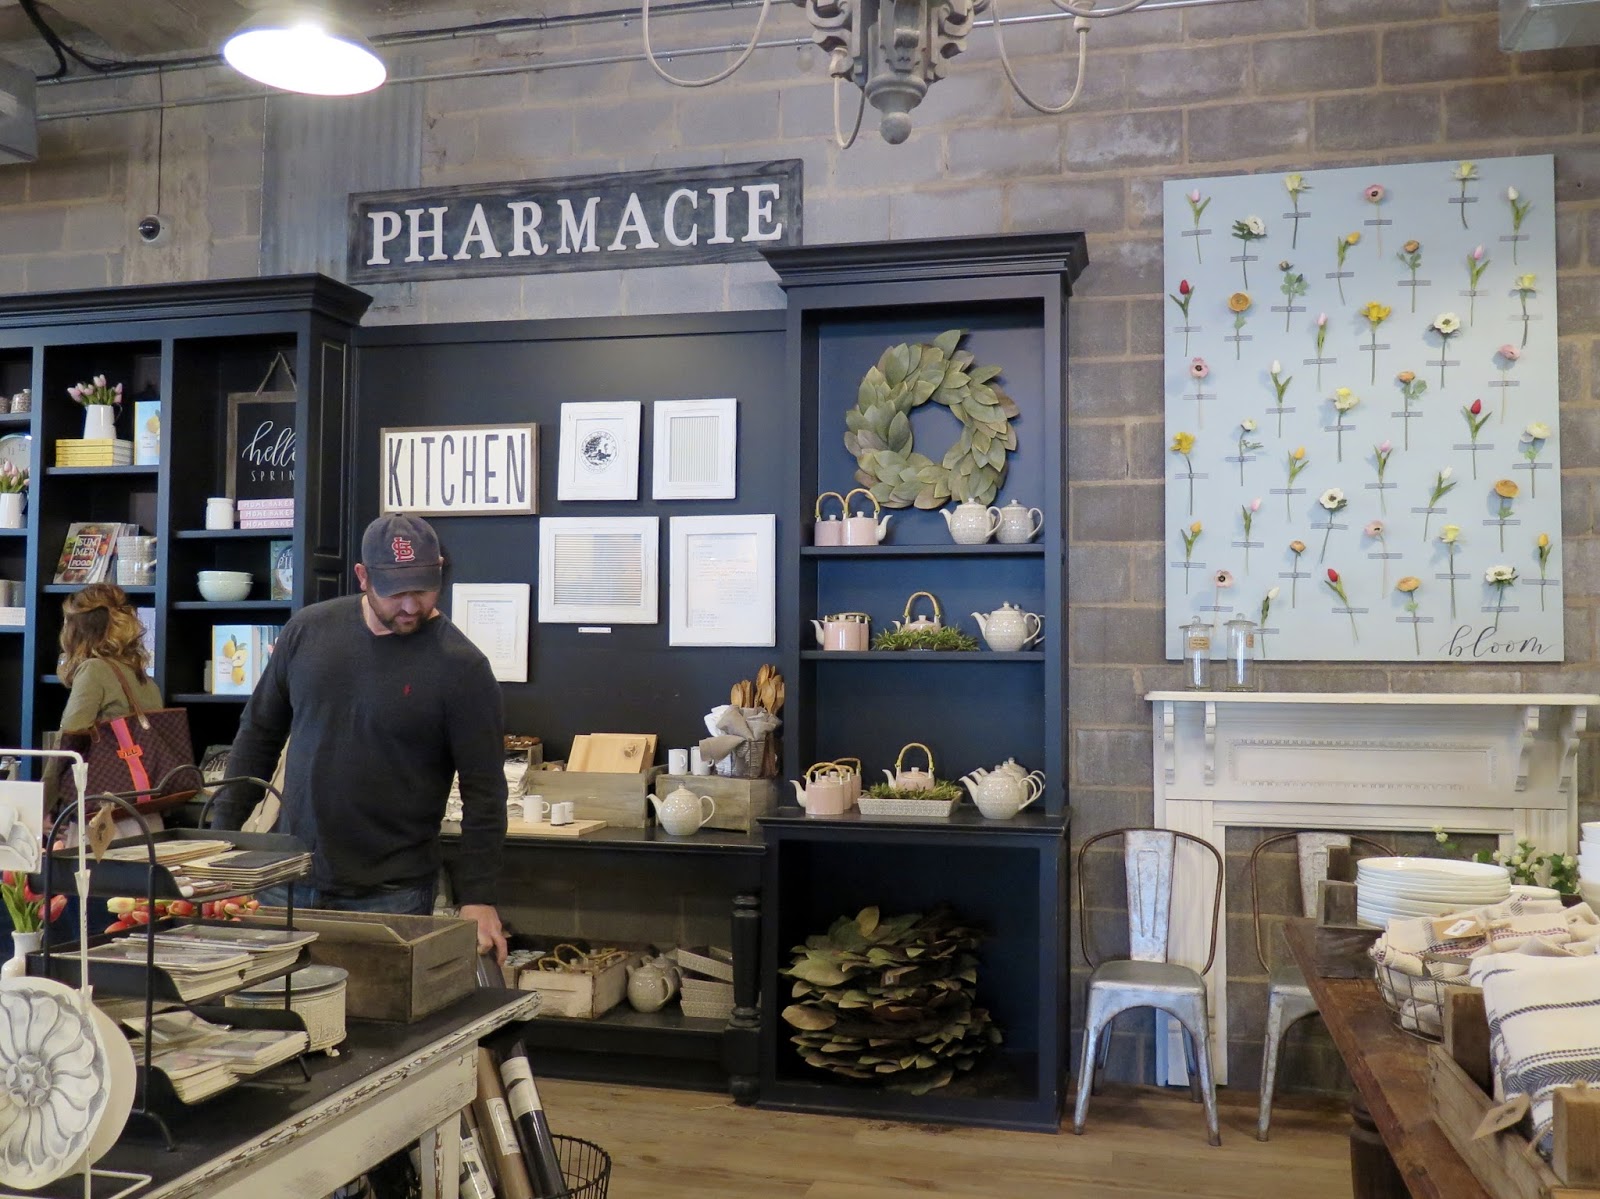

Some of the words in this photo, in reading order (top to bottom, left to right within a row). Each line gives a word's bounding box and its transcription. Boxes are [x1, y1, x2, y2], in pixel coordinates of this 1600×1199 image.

[366, 183, 783, 265] PHARMACIE
[388, 433, 526, 507] KITCHEN
[246, 510, 267, 518] HOME
[246, 519, 268, 527] HOME
[74, 548, 95, 556] MER
[71, 559, 93, 567] FOOD
[1439, 625, 1557, 657] bloom
